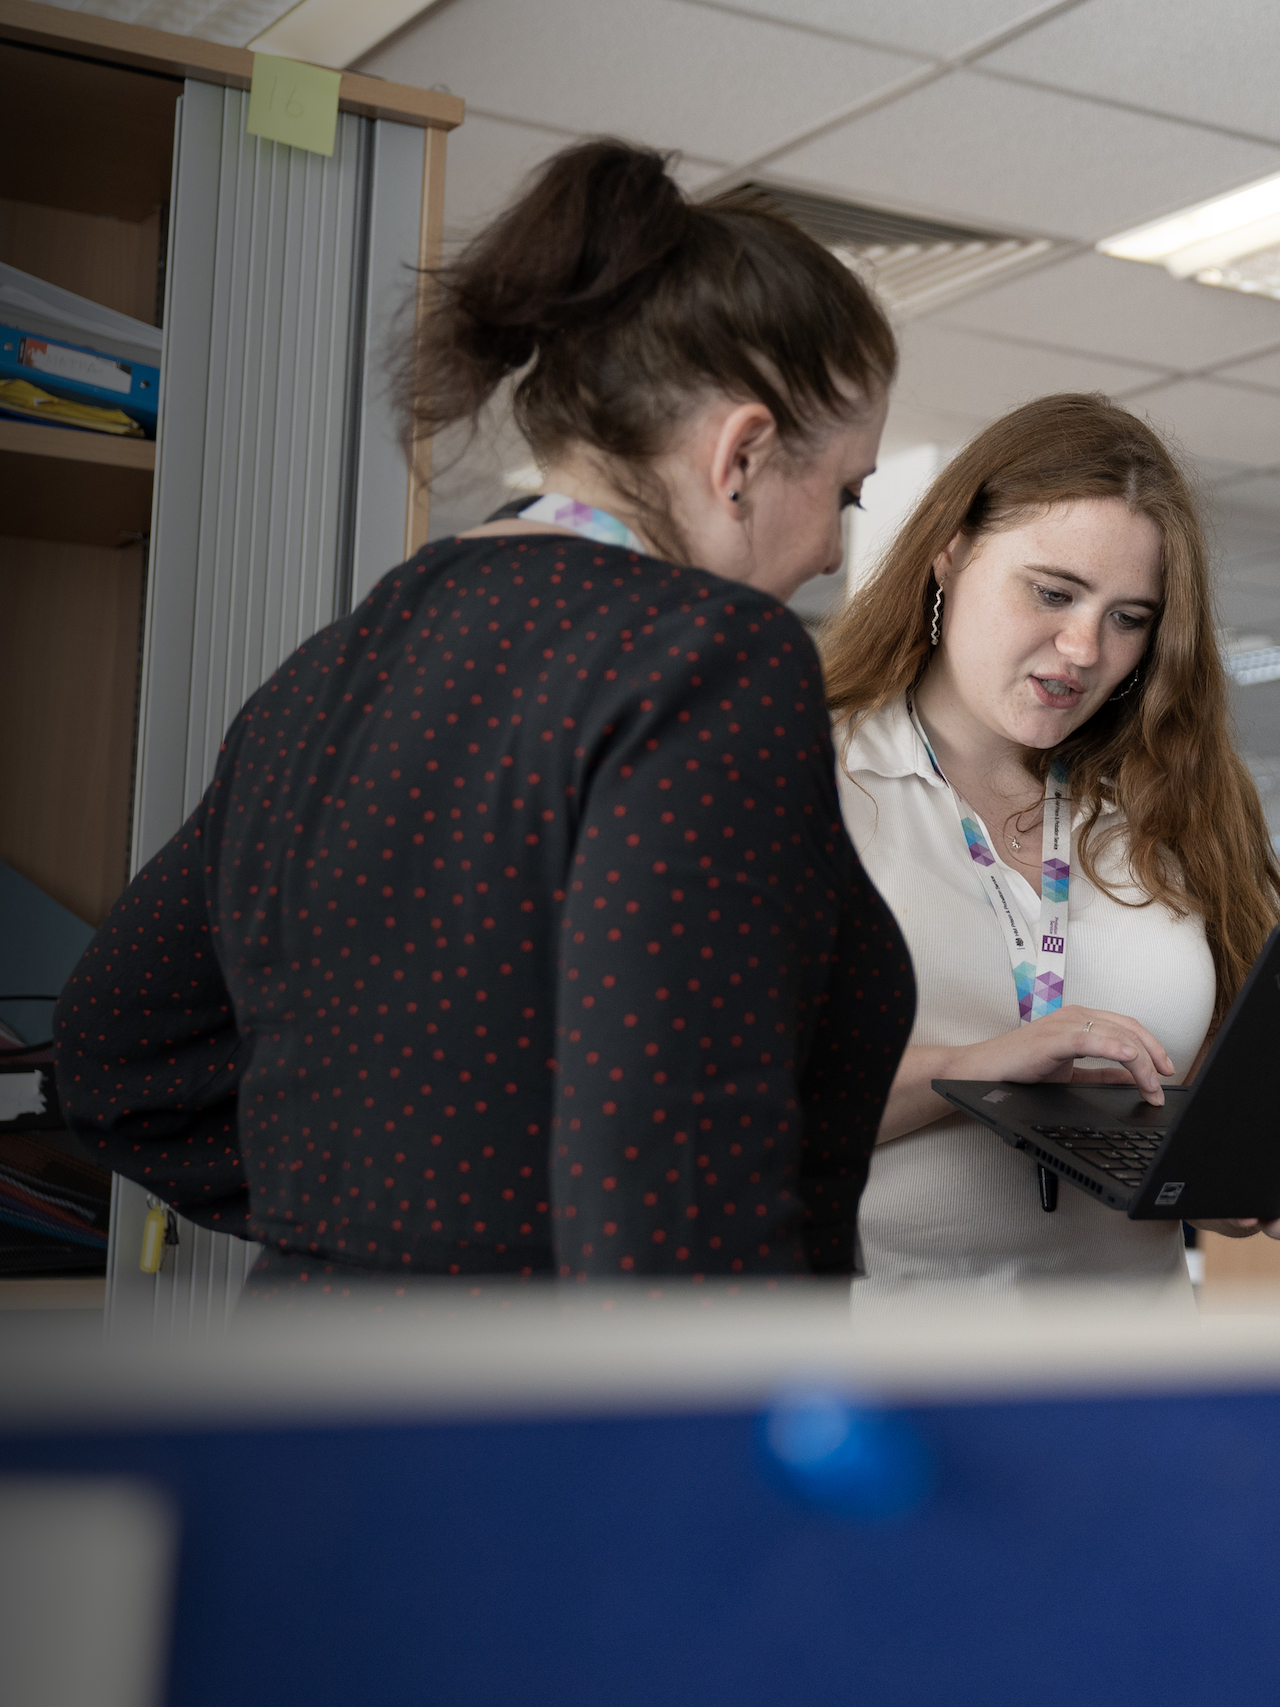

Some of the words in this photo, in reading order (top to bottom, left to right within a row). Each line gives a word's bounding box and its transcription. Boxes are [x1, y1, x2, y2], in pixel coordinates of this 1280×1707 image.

[268, 74, 305, 119] 16
[990, 875, 1000, 890] Service
[997, 890, 1009, 910] Probation
[1007, 914, 1016, 928] Prison
[1012, 928, 1019, 937] HM
